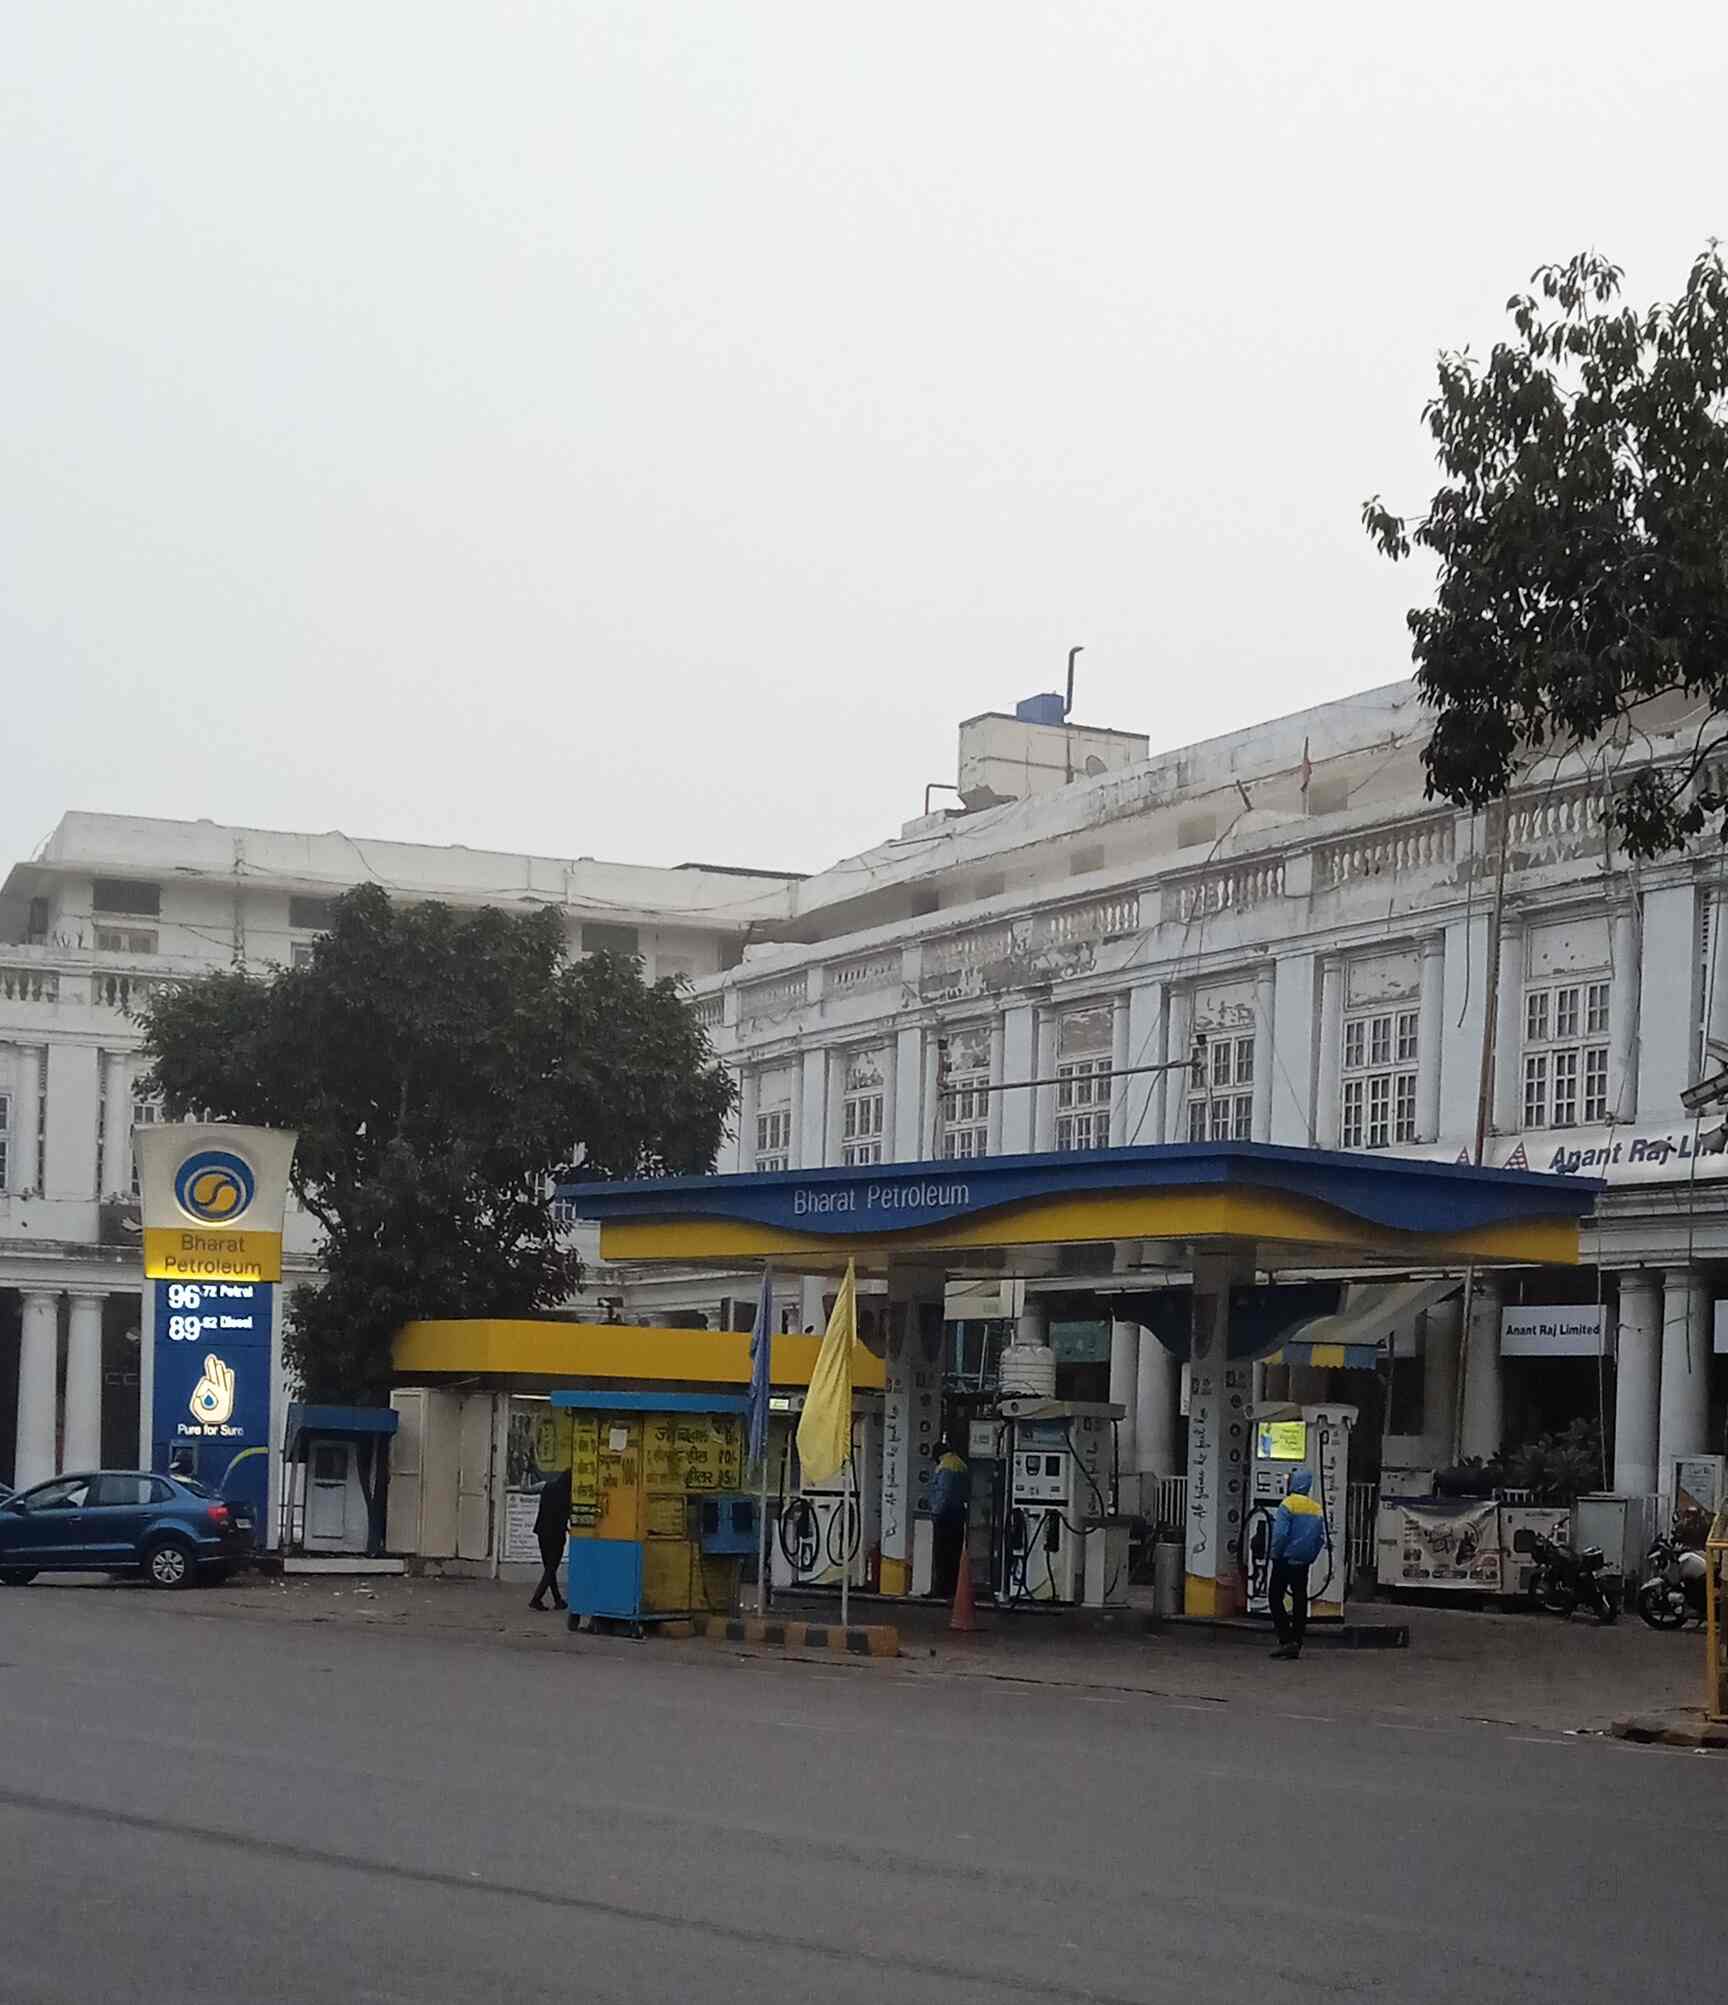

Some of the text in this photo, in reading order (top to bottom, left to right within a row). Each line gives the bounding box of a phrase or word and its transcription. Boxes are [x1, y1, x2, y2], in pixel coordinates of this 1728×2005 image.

[1549, 1144, 1623, 1168] Anant
[1628, 1136, 1673, 1165] Raj
[794, 1182, 969, 1216] Bharat Petroleum
[181, 1234, 247, 1252] Bharat
[164, 1255, 262, 1276] Petroleum
[219, 1284, 253, 1298] Petrol
[219, 1315, 253, 1329] Diesel
[1505, 1323, 1601, 1338] Anant Raj Limited
[177, 1423, 245, 1437] Pure for Sure
